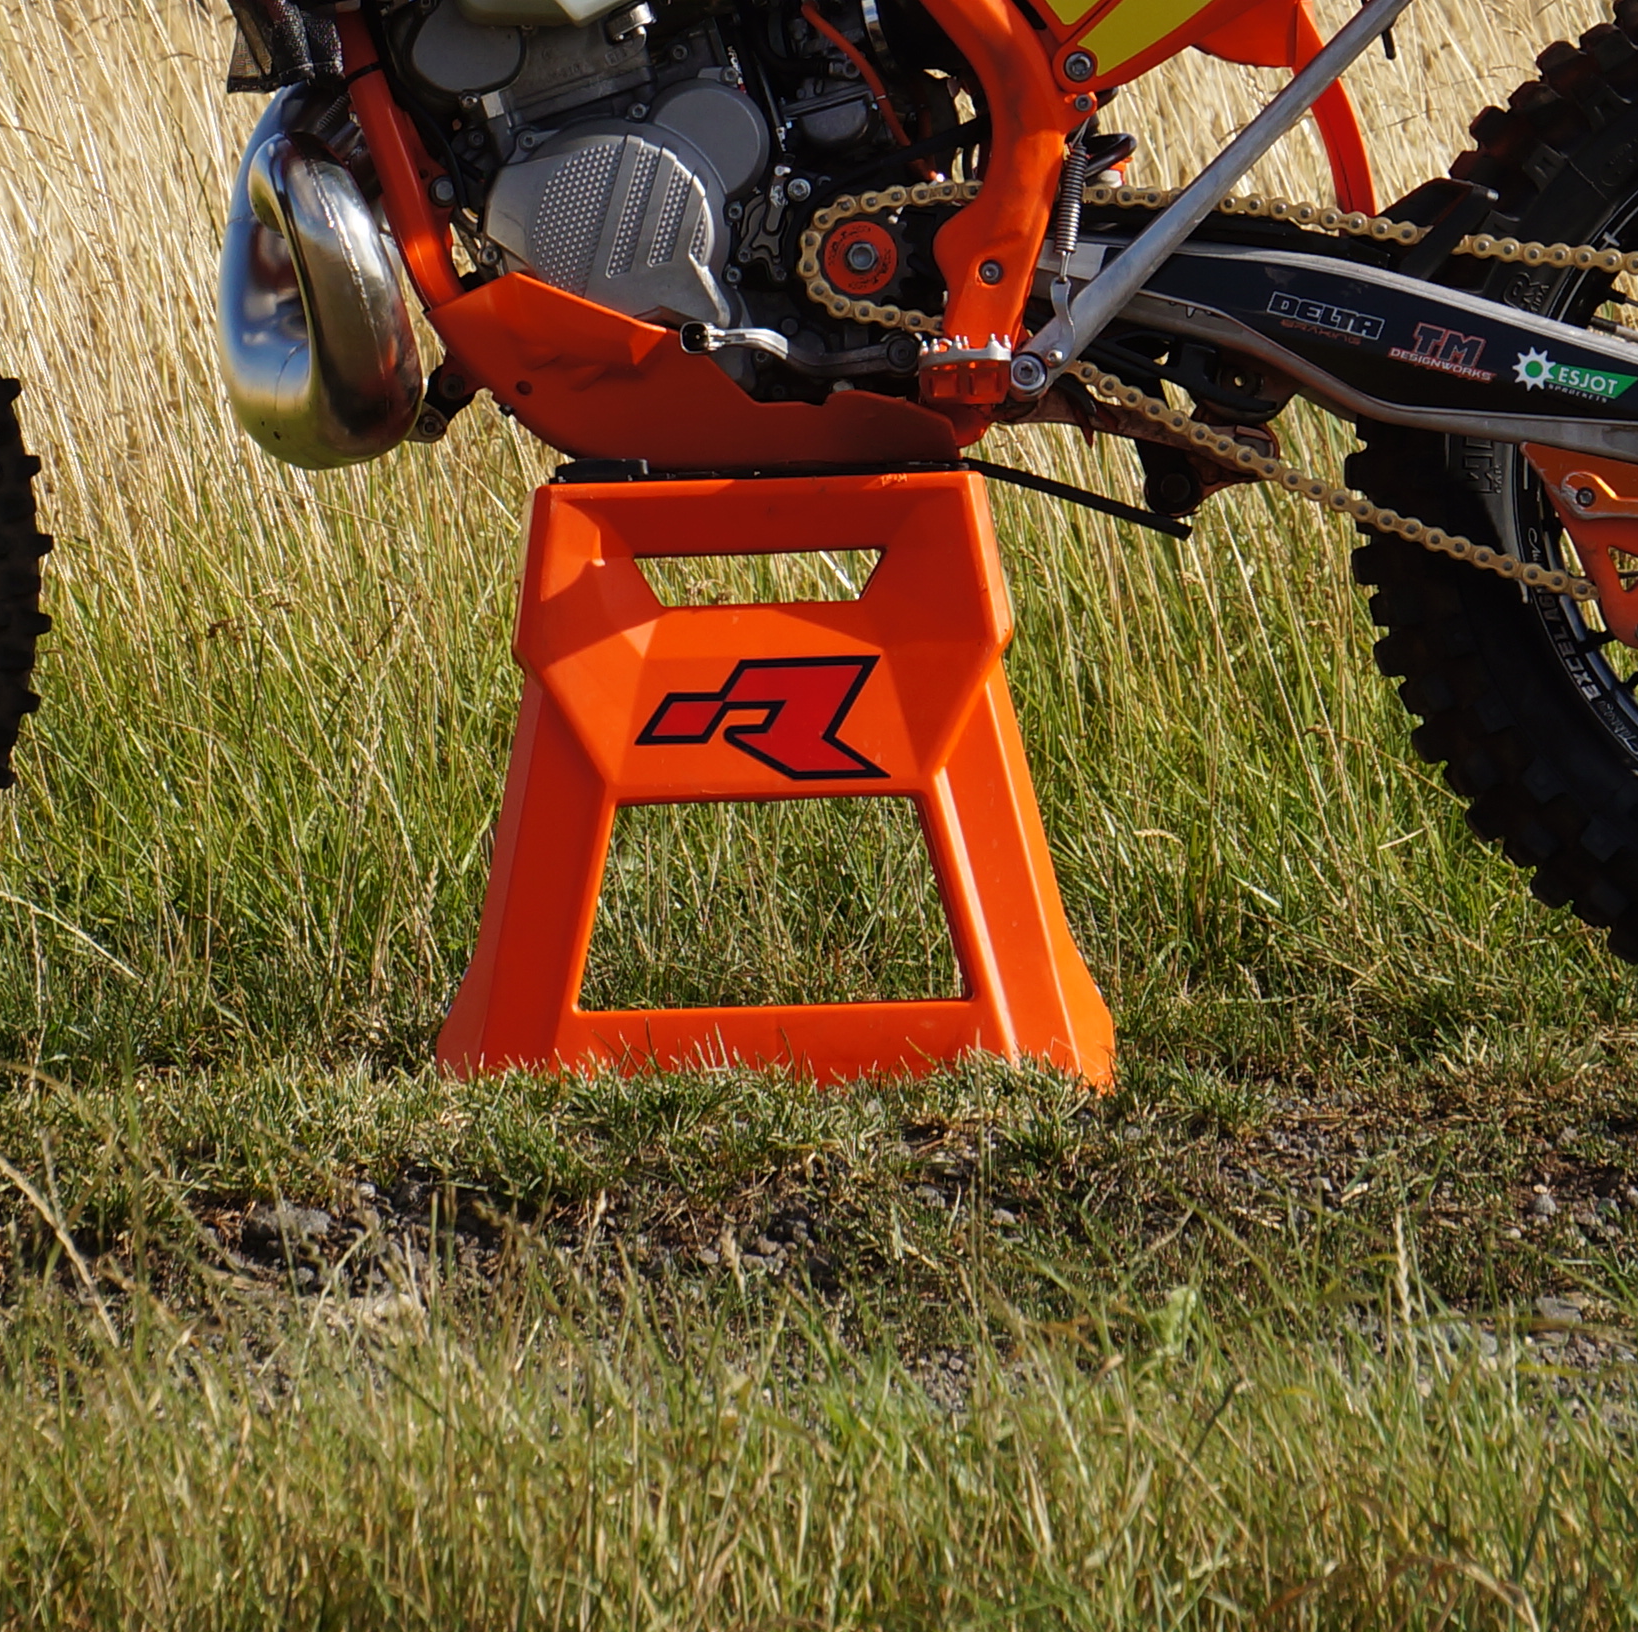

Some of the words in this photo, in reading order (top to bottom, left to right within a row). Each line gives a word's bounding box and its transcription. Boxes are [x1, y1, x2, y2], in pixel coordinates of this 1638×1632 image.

[1267, 291, 1386, 340] DELTA
[1390, 346, 1493, 382] DESIGNWORKS
[1414, 322, 1487, 368] TM
[1558, 366, 1619, 396] ESJOT
[1552, 625, 1603, 701] EXCEL
